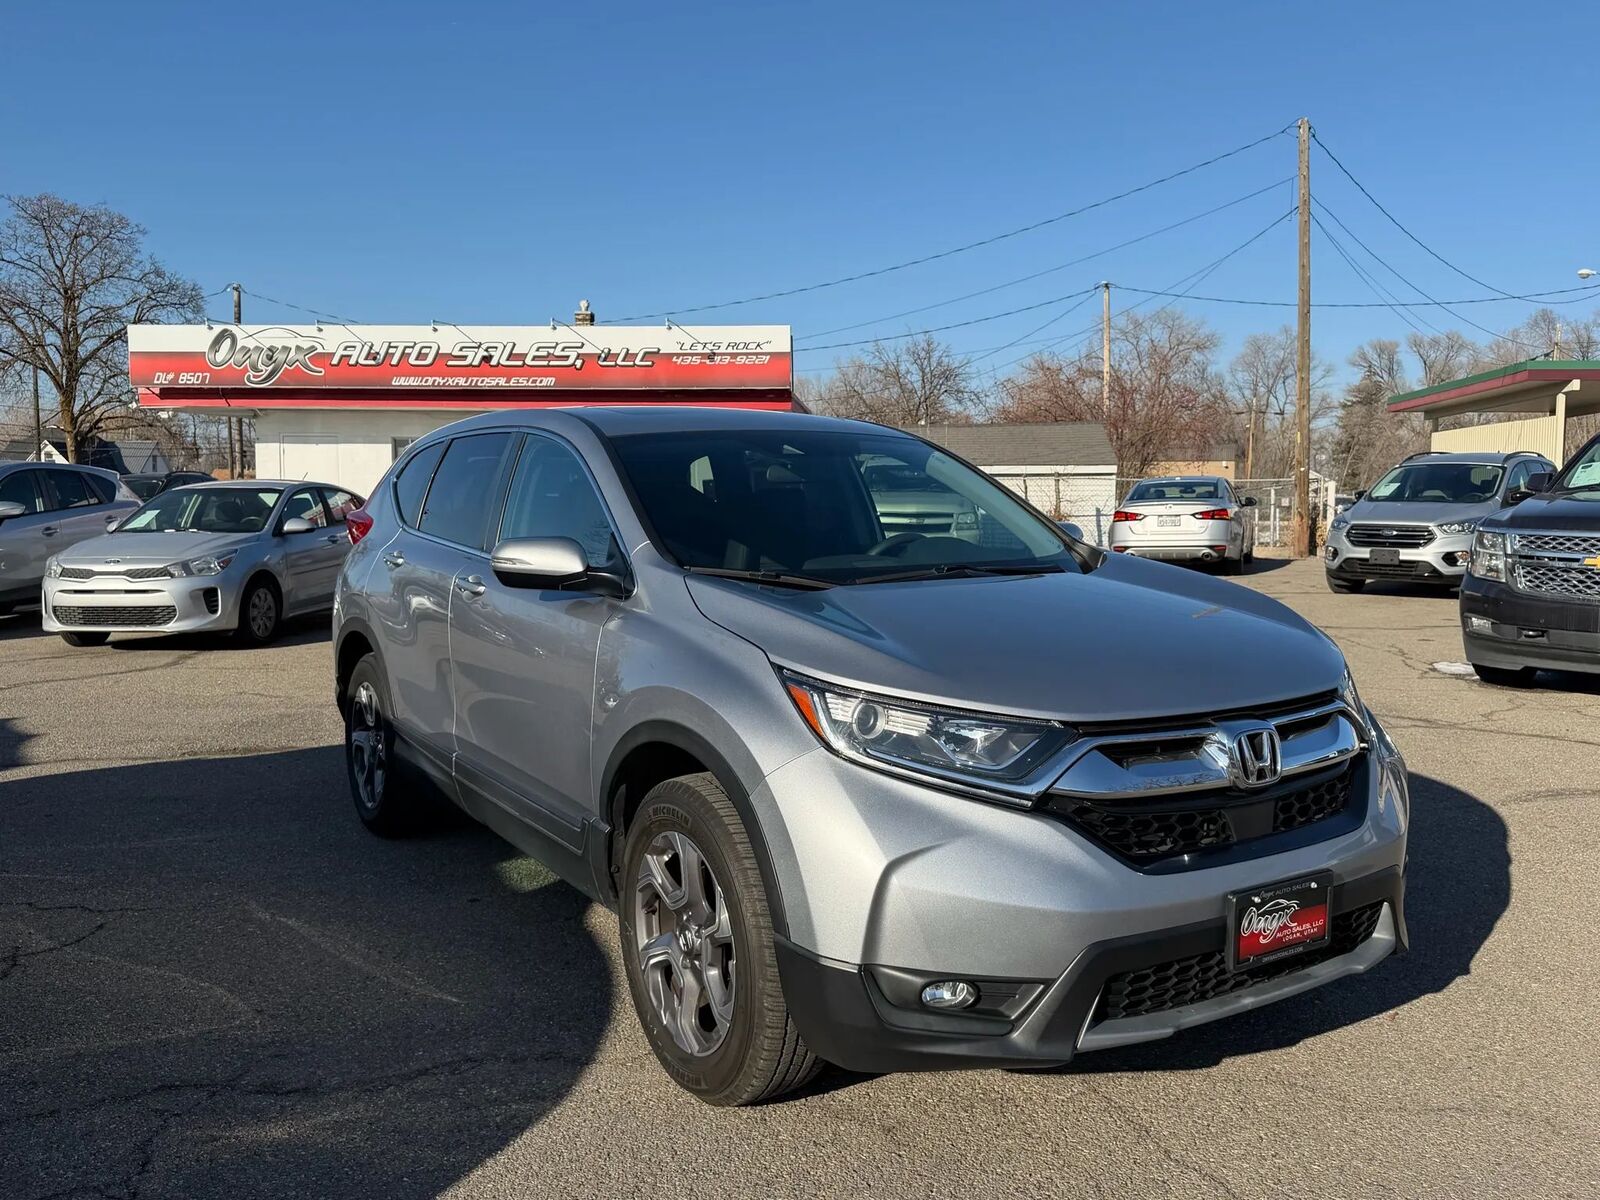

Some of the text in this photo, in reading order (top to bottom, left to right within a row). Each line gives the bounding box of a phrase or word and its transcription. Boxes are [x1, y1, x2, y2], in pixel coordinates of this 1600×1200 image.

[205, 327, 661, 387] Onyx AUTO SALES, LLC
[153, 372, 210, 384] DL# 8507
[1241, 906, 1298, 944] Onyx
[1276, 928, 1292, 938] AUTO
[1313, 919, 1325, 928] LLC
[1304, 927, 1318, 936] UTAH
